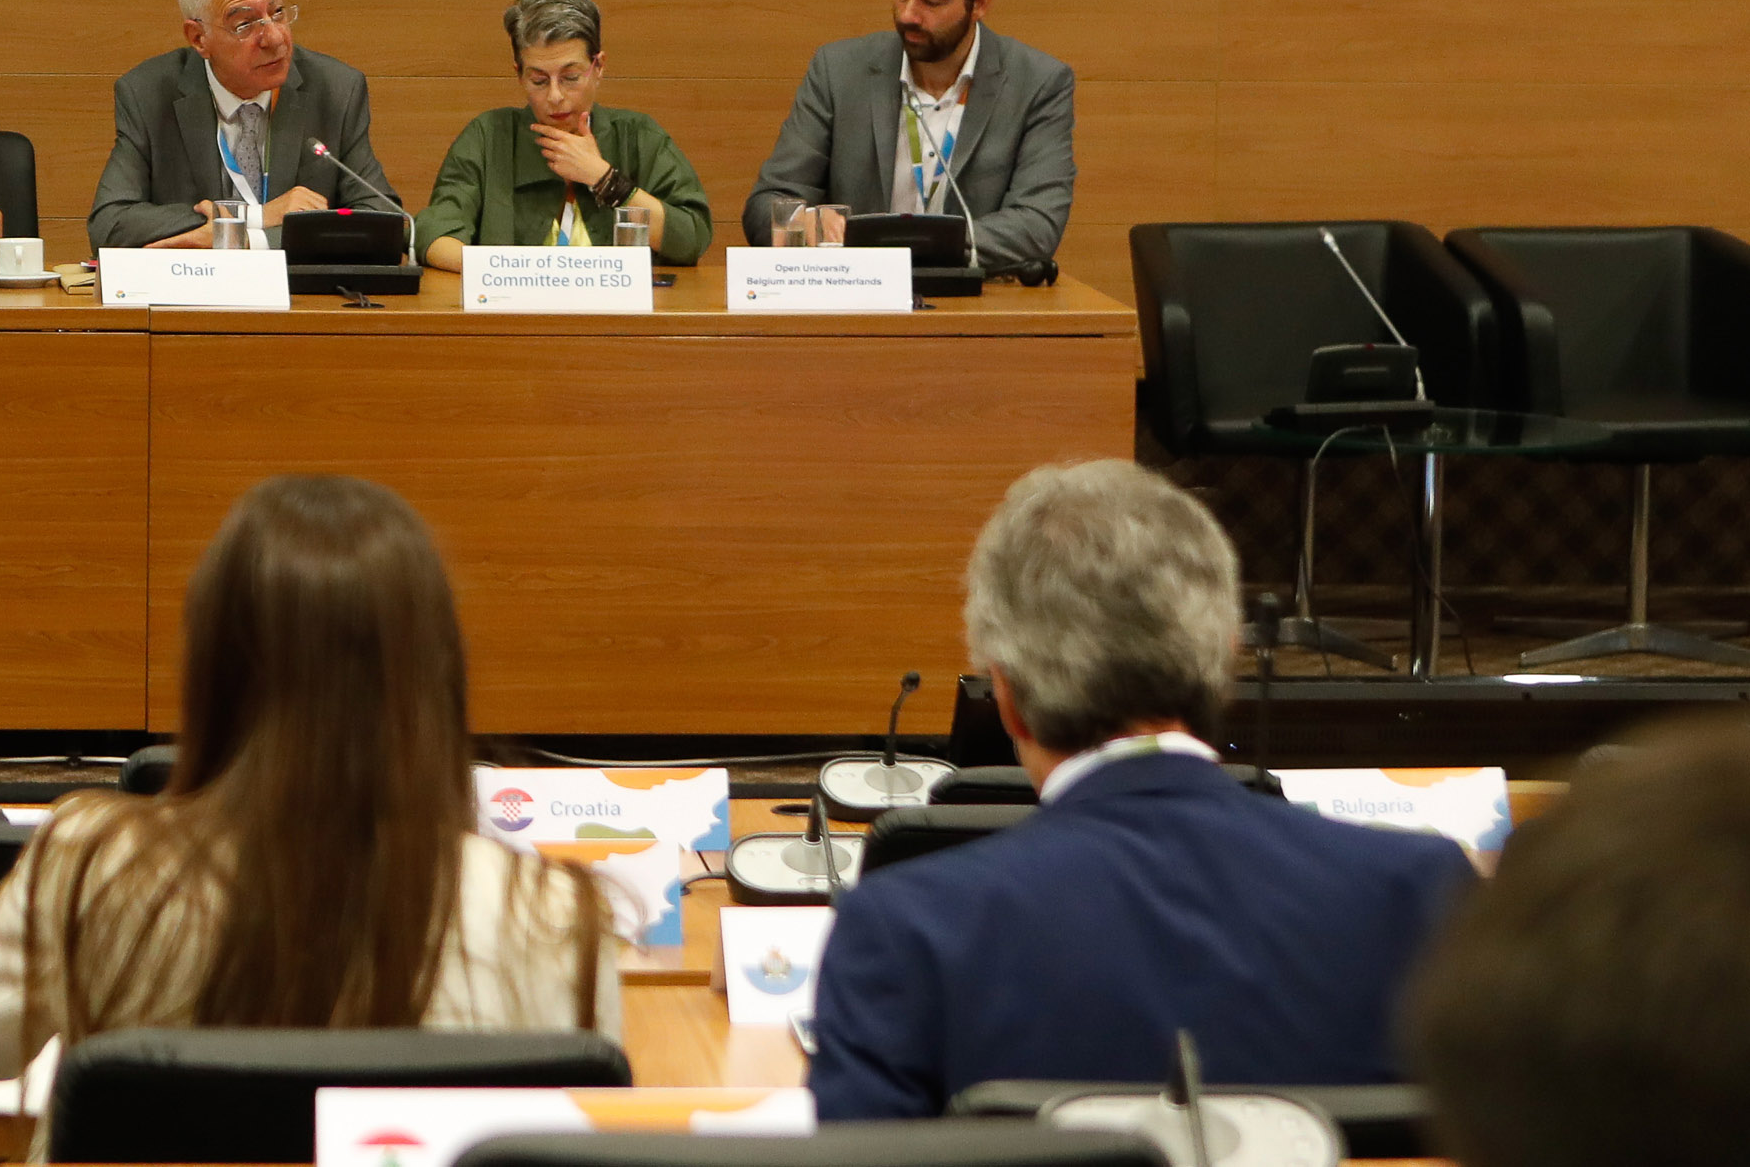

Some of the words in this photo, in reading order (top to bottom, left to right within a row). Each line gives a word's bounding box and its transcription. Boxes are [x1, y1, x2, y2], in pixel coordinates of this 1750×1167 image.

[170, 263, 216, 277] Chair
[489, 255, 531, 269] Chair
[536, 256, 552, 269] of
[556, 255, 623, 272] Steering
[775, 264, 800, 274] Open
[802, 264, 850, 274] University
[481, 273, 570, 287] Committee
[574, 277, 595, 288] on
[599, 274, 632, 288] ESD
[746, 277, 785, 286] Belgium
[787, 277, 805, 285] and
[808, 277, 823, 285] the
[825, 277, 882, 286] Netherlands
[550, 799, 621, 816] Croatia
[1332, 797, 1414, 817] Bulgaria
